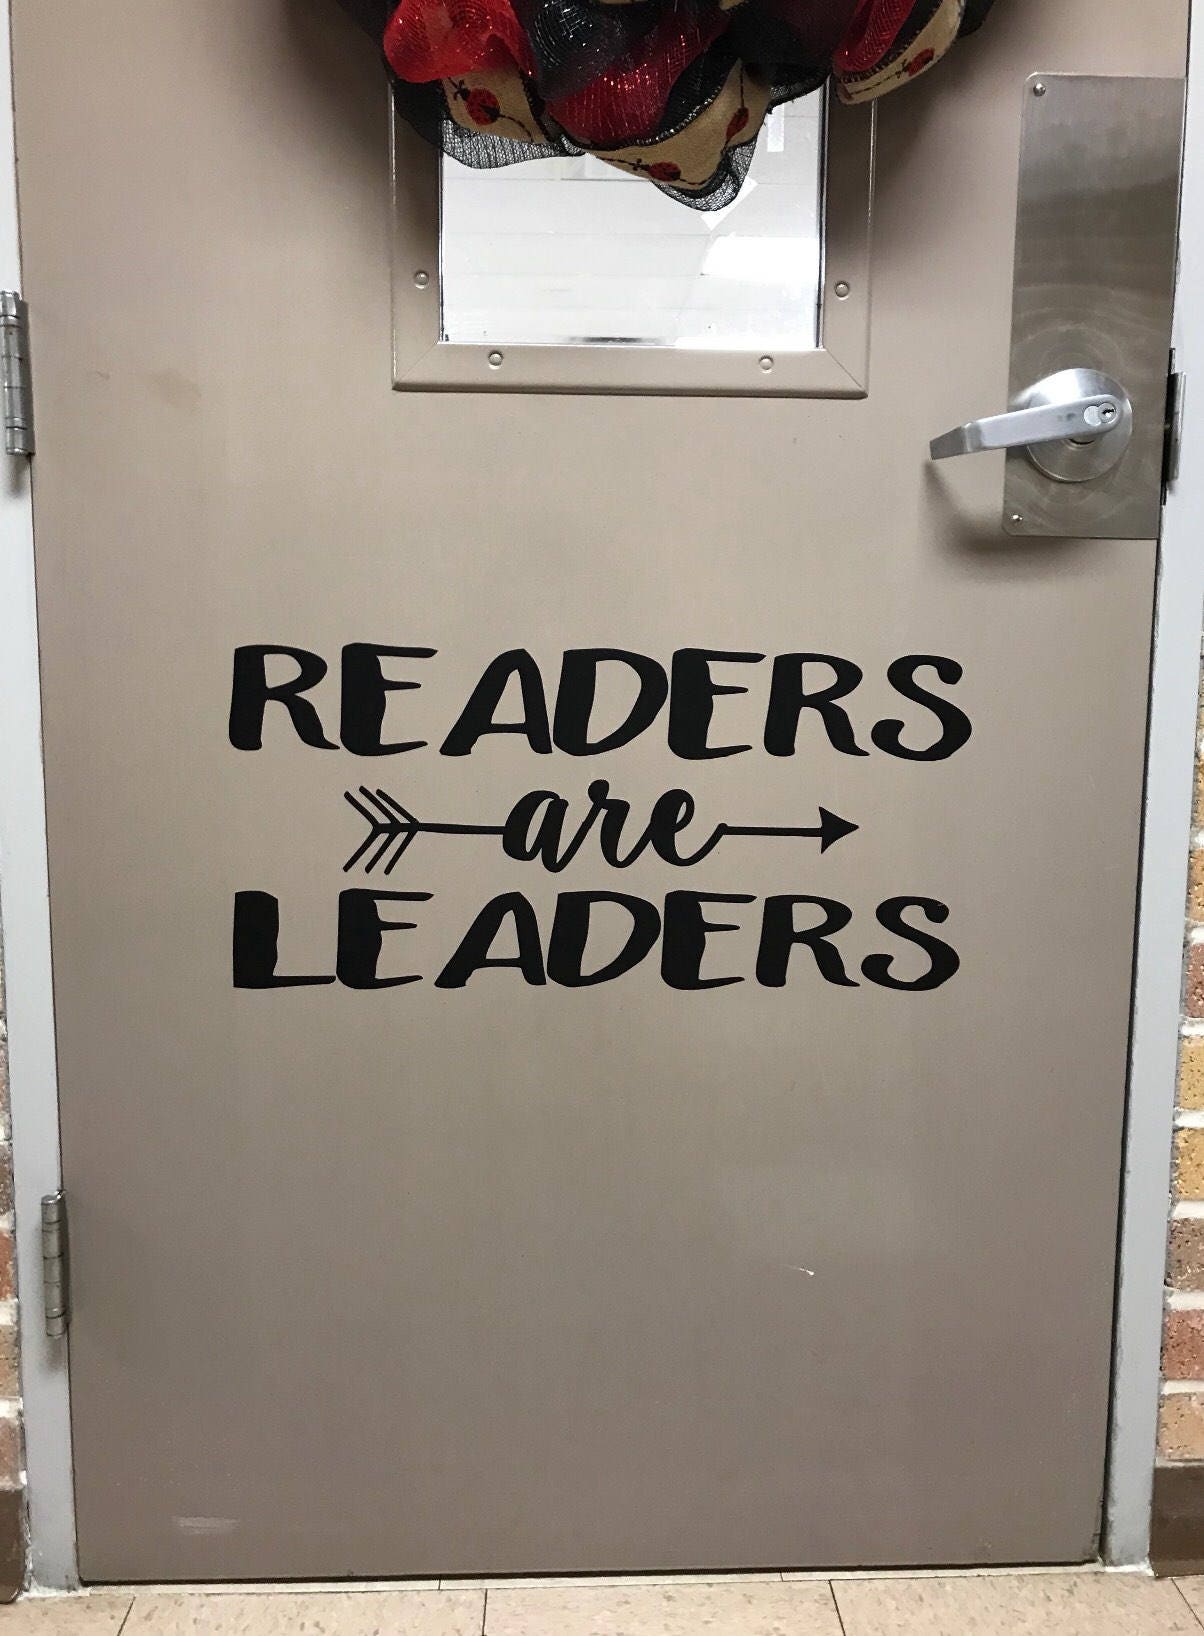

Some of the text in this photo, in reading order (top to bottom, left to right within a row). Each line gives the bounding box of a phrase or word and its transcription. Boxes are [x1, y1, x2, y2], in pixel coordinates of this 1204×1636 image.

[229, 643, 972, 761] READERS
[503, 779, 727, 873] are
[233, 888, 960, 991] LEADERS
